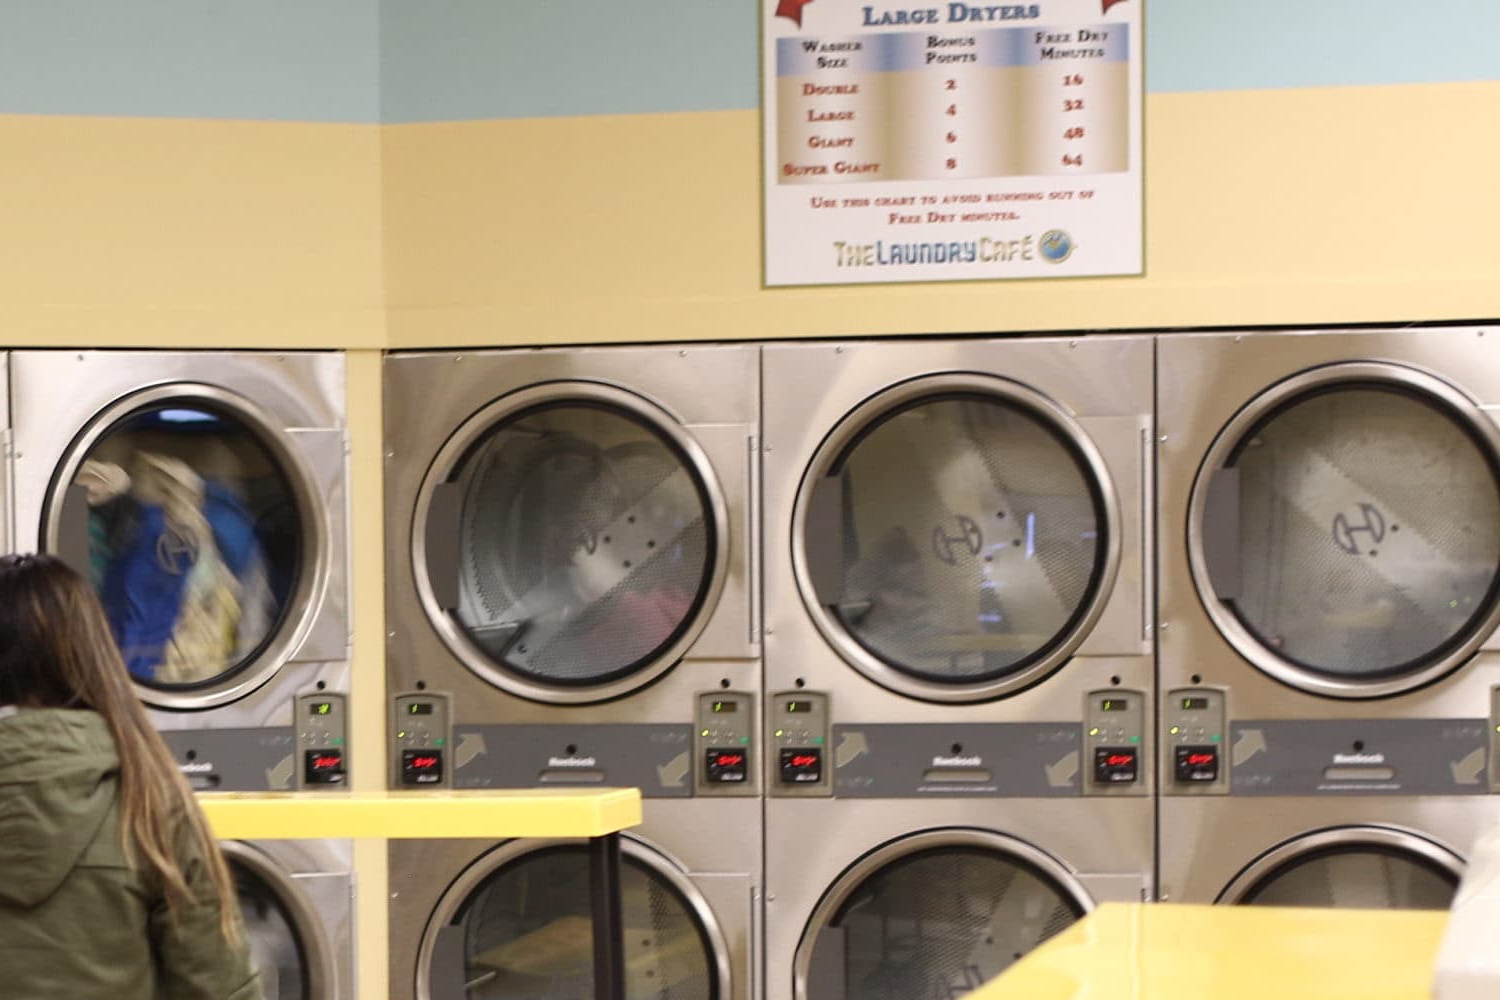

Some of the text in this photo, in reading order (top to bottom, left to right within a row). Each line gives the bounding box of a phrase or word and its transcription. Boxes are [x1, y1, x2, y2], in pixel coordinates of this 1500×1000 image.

[862, 3, 1040, 26] LARGE DRYERS
[946, 79, 957, 91] 2
[1063, 73, 1084, 86] 16
[1062, 99, 1084, 112] 32
[807, 109, 854, 122] LARGE
[1062, 127, 1084, 140] 48
[1061, 153, 1083, 167] 64
